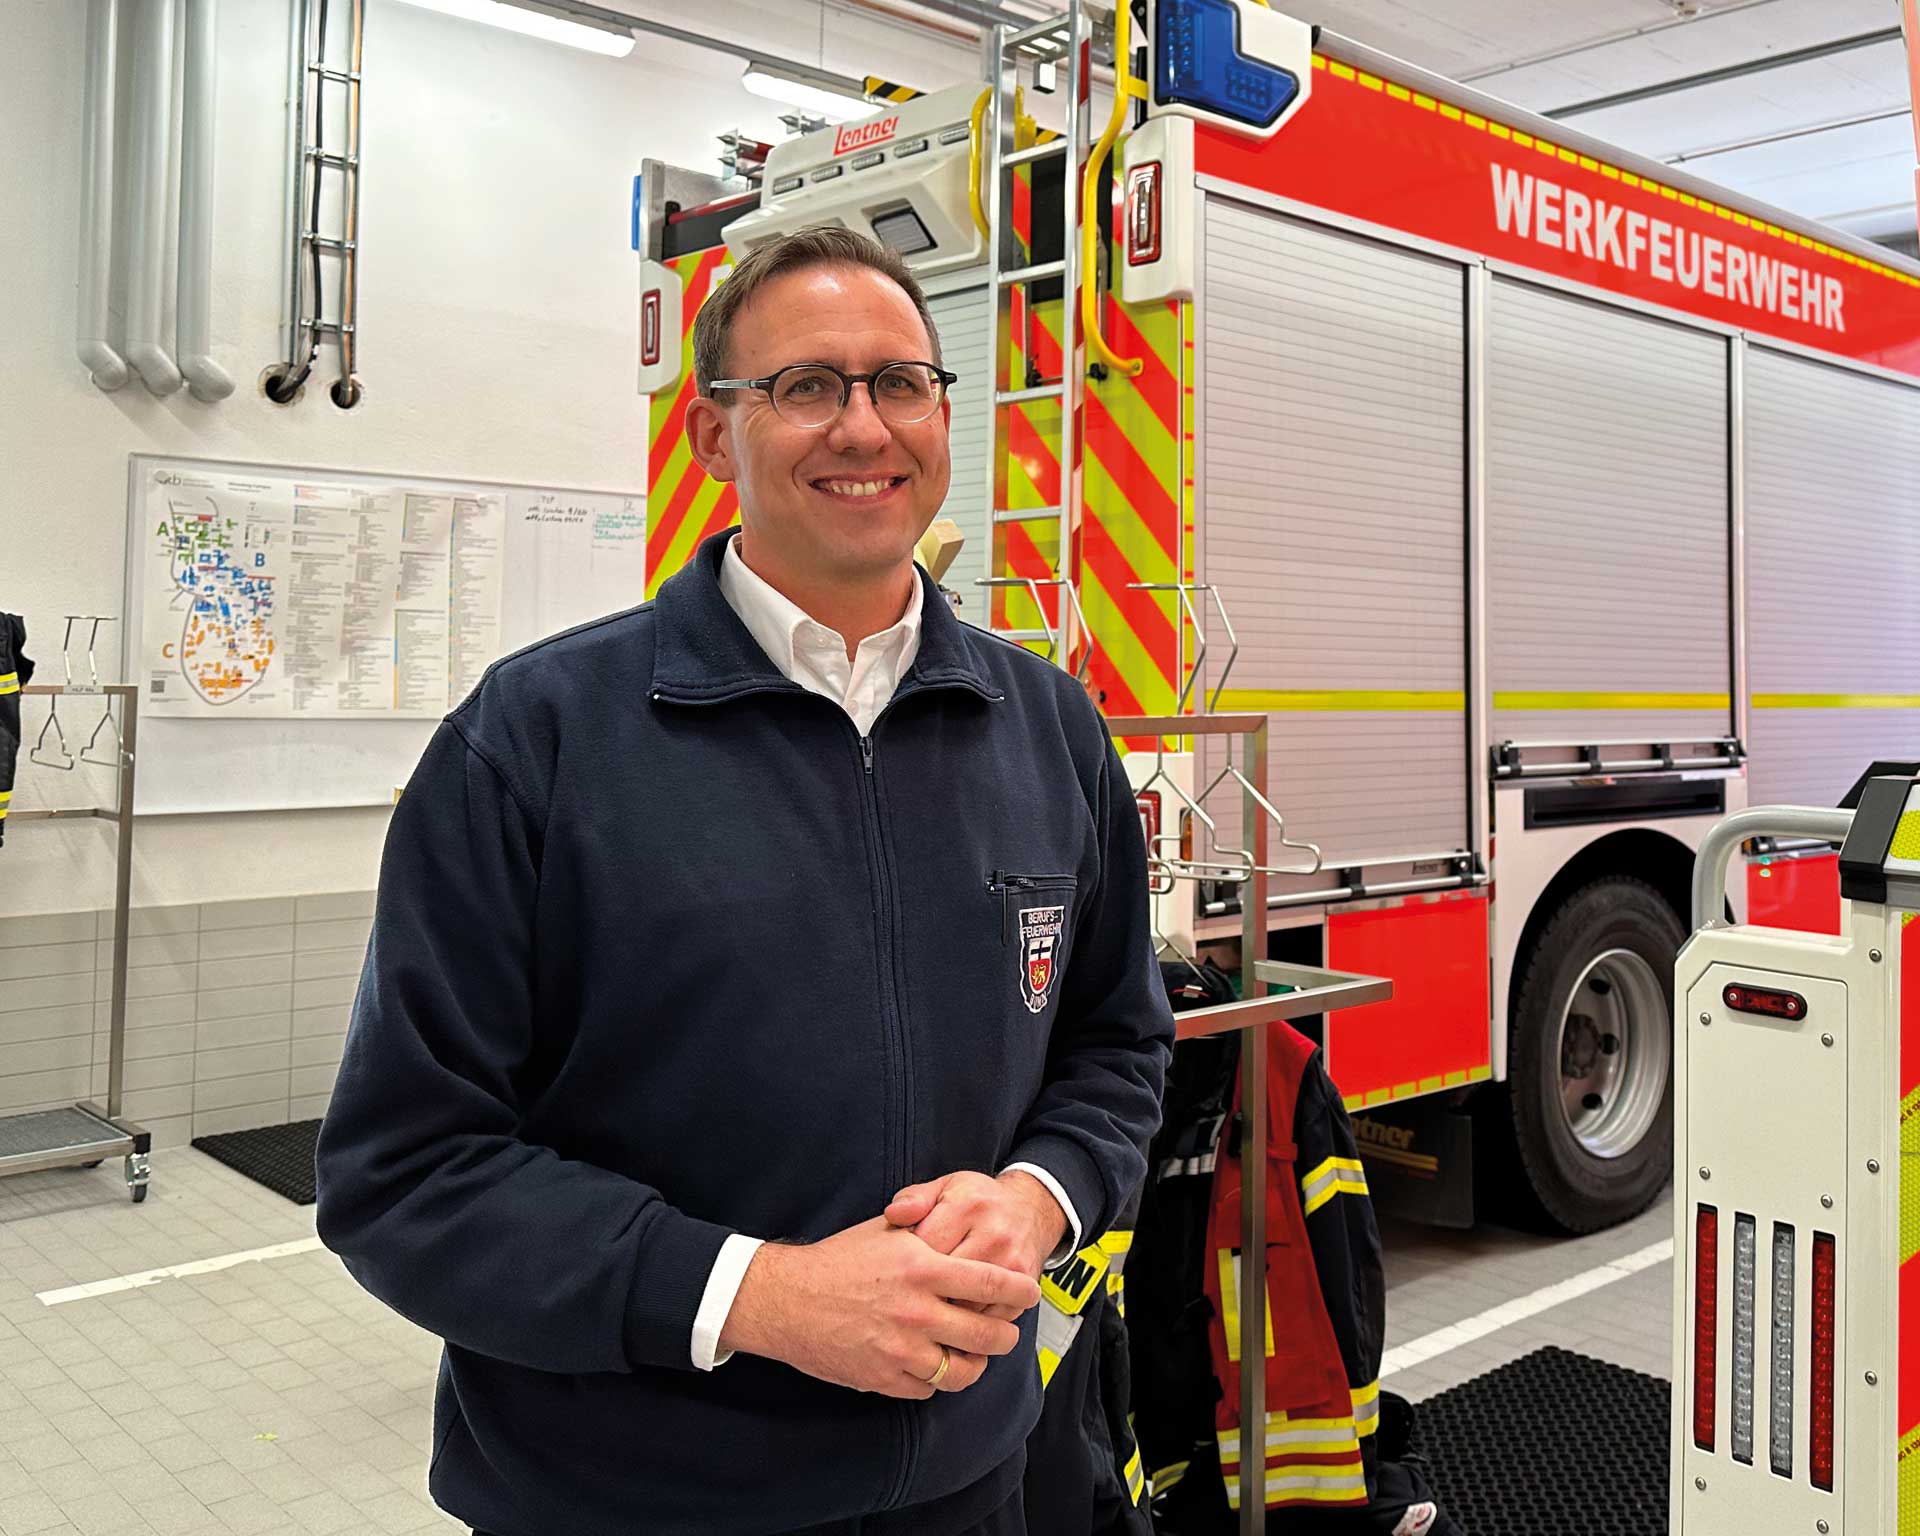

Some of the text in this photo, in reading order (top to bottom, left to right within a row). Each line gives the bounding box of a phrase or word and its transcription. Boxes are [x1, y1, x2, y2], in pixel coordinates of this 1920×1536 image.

[833, 115, 899, 156] Lentner
[1489, 162, 1846, 333] WERKFEUERWEHR
[156, 521, 169, 537] A
[254, 552, 265, 567] B
[162, 642, 174, 658] C
[1028, 911, 1058, 924] BERUFS-
[1022, 923, 1062, 938] FEUERWEHR
